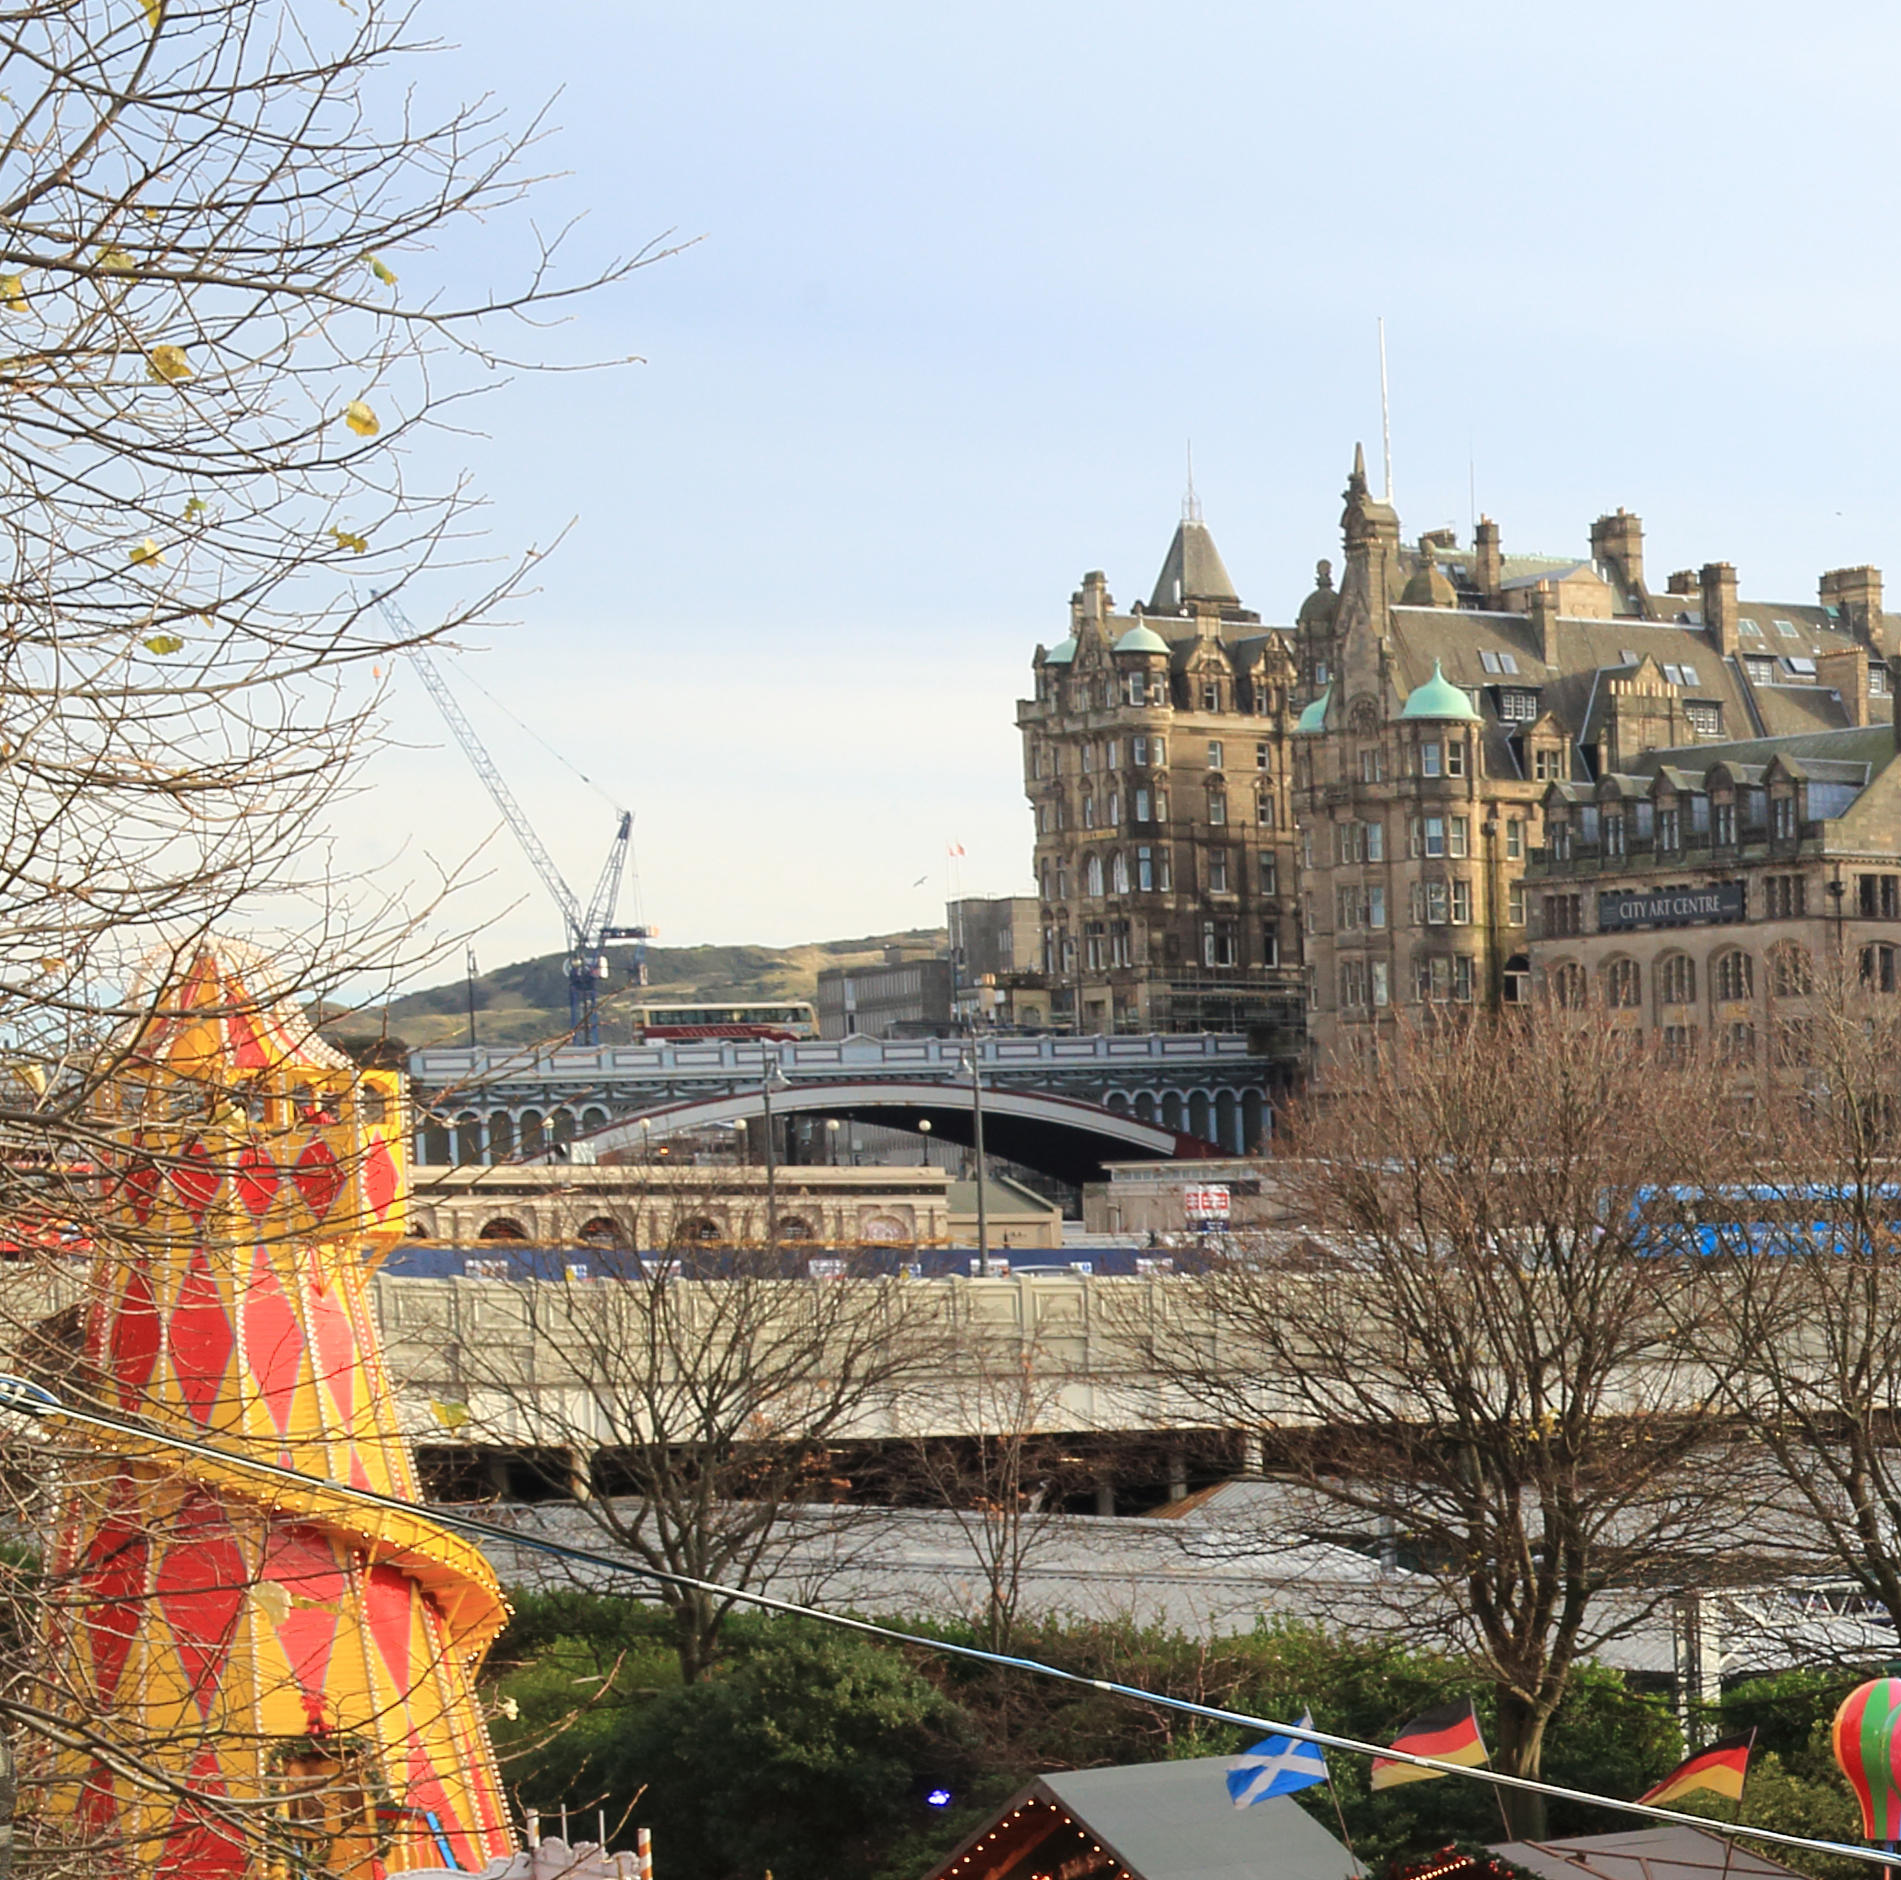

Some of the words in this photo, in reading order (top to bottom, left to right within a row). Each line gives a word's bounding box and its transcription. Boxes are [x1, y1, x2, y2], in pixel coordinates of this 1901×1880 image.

[1619, 901, 1647, 919] CITY
[1649, 899, 1671, 917] ART
[1673, 895, 1720, 915] CENTRE
